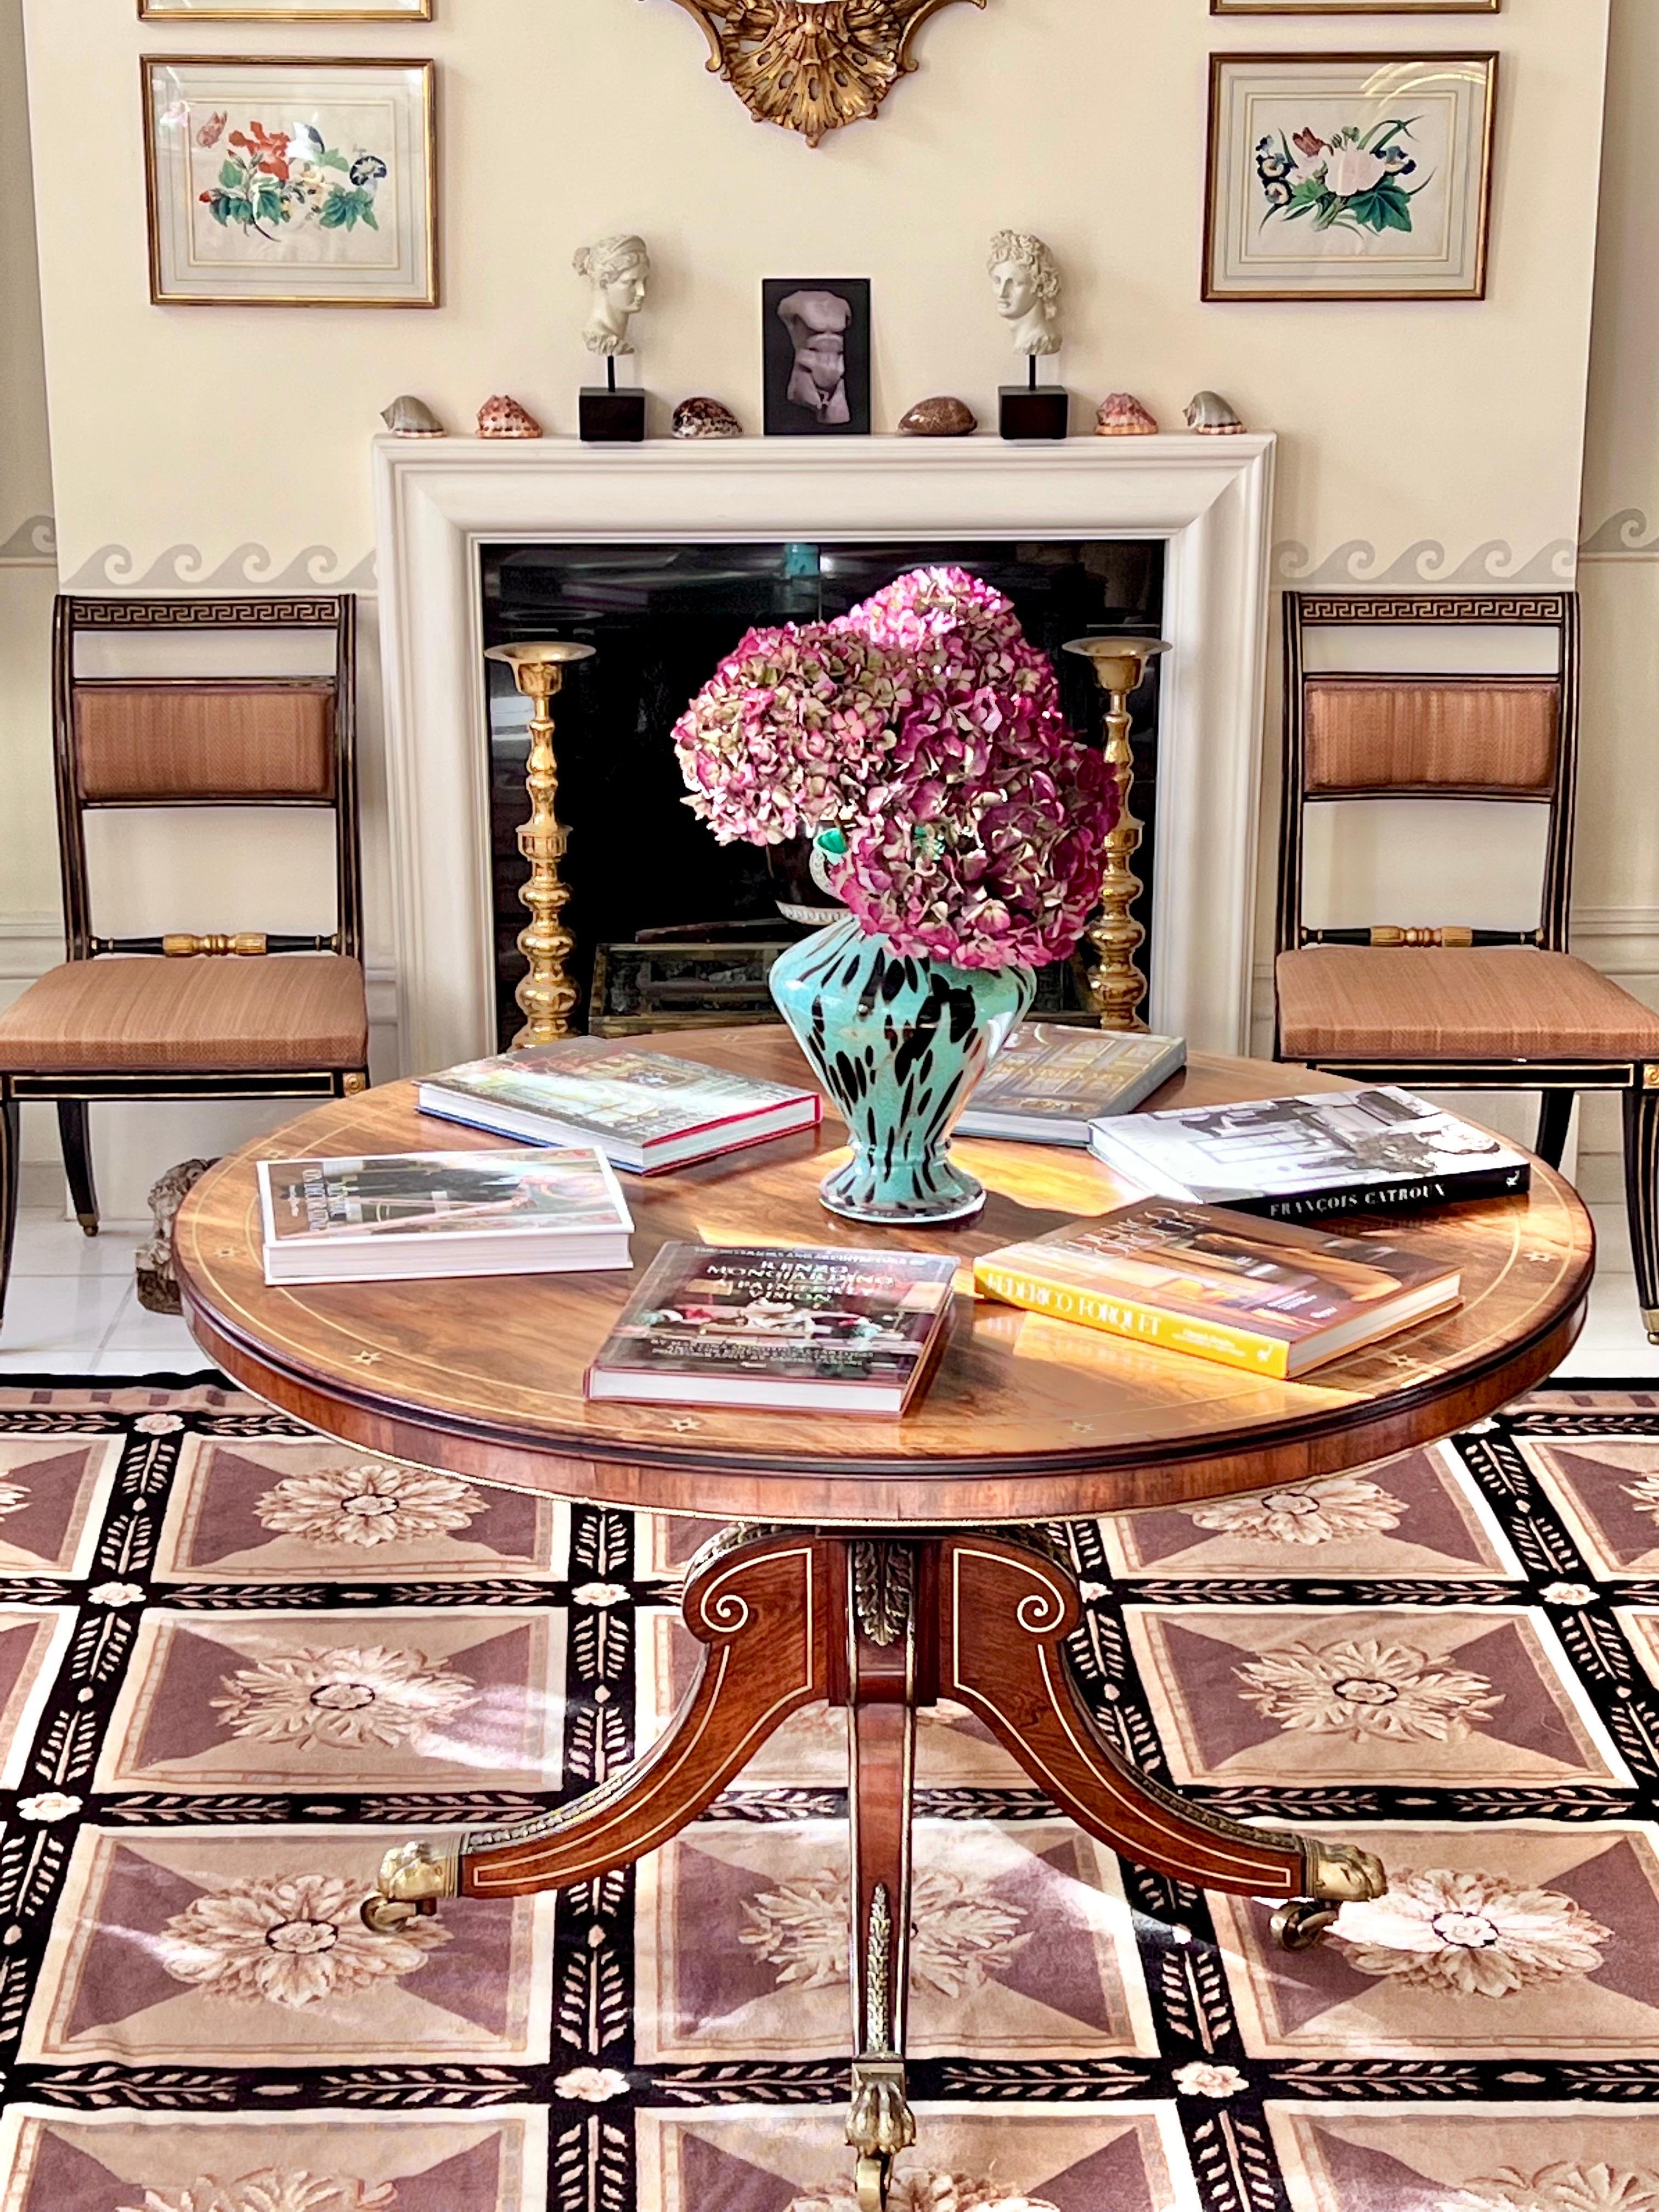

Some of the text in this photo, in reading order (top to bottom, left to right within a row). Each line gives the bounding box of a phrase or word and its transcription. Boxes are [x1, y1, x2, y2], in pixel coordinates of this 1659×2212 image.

[1270, 1183, 1445, 1217] FRANÇOIS CATROUX
[761, 1261, 848, 1273] RENZO
